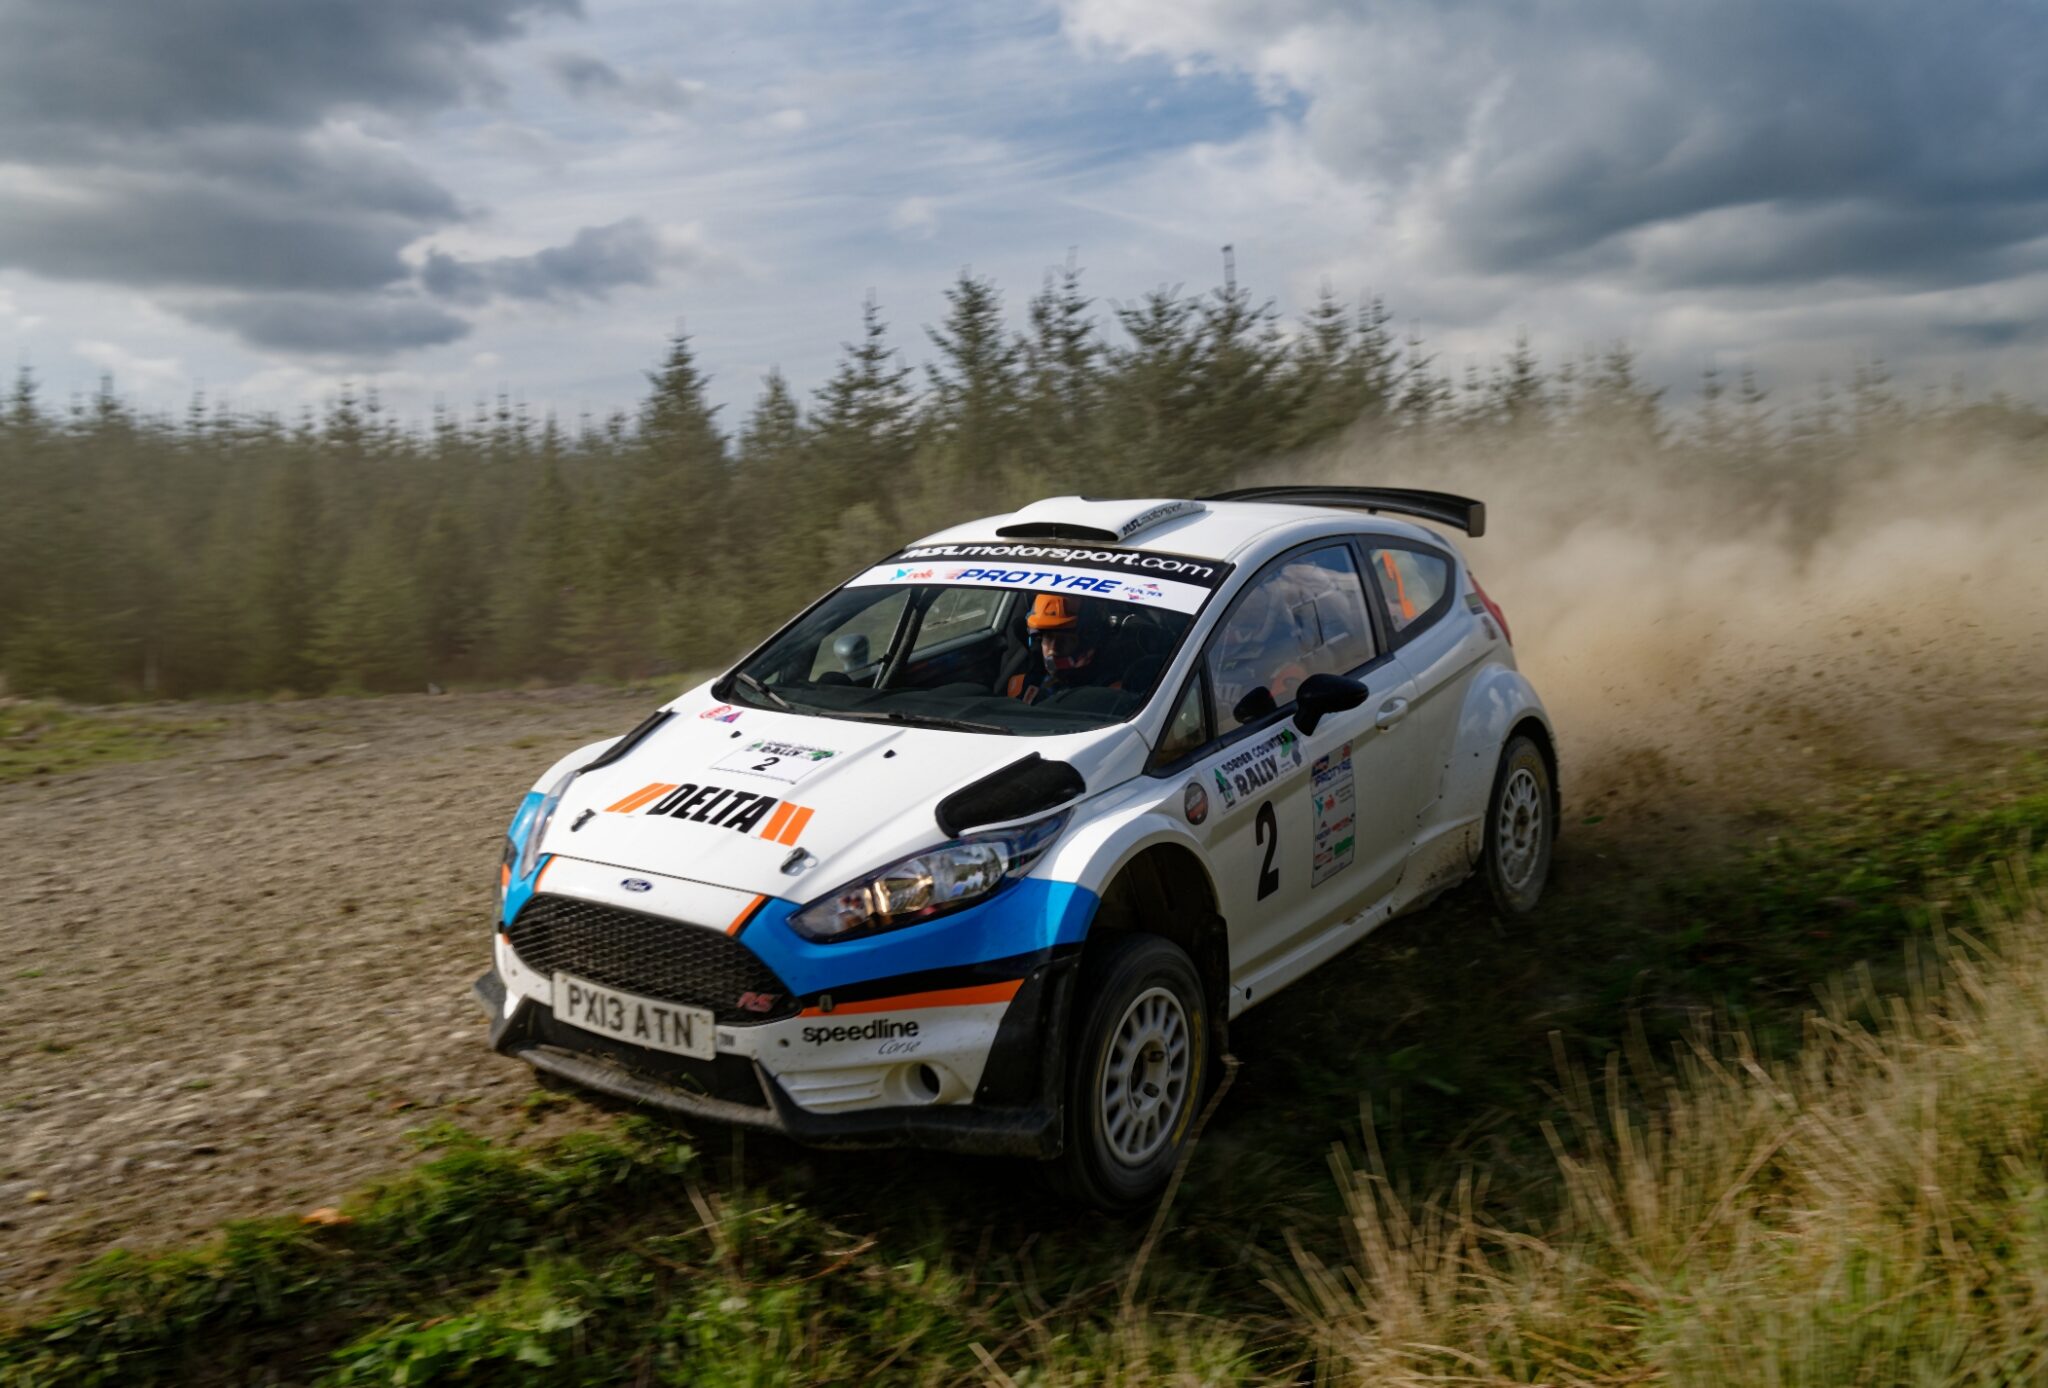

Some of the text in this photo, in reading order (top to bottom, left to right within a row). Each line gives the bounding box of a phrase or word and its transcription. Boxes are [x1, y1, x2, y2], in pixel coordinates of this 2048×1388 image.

[957, 568, 1122, 593] PROTYRE
[752, 757, 780, 771] 2
[1233, 756, 1279, 796] RALLY
[646, 783, 779, 834] DELTA
[1255, 800, 1279, 901] 2
[568, 984, 693, 1049] PX13 ATN
[803, 1019, 919, 1046] speedline
[878, 1040, 922, 1055] Corse
